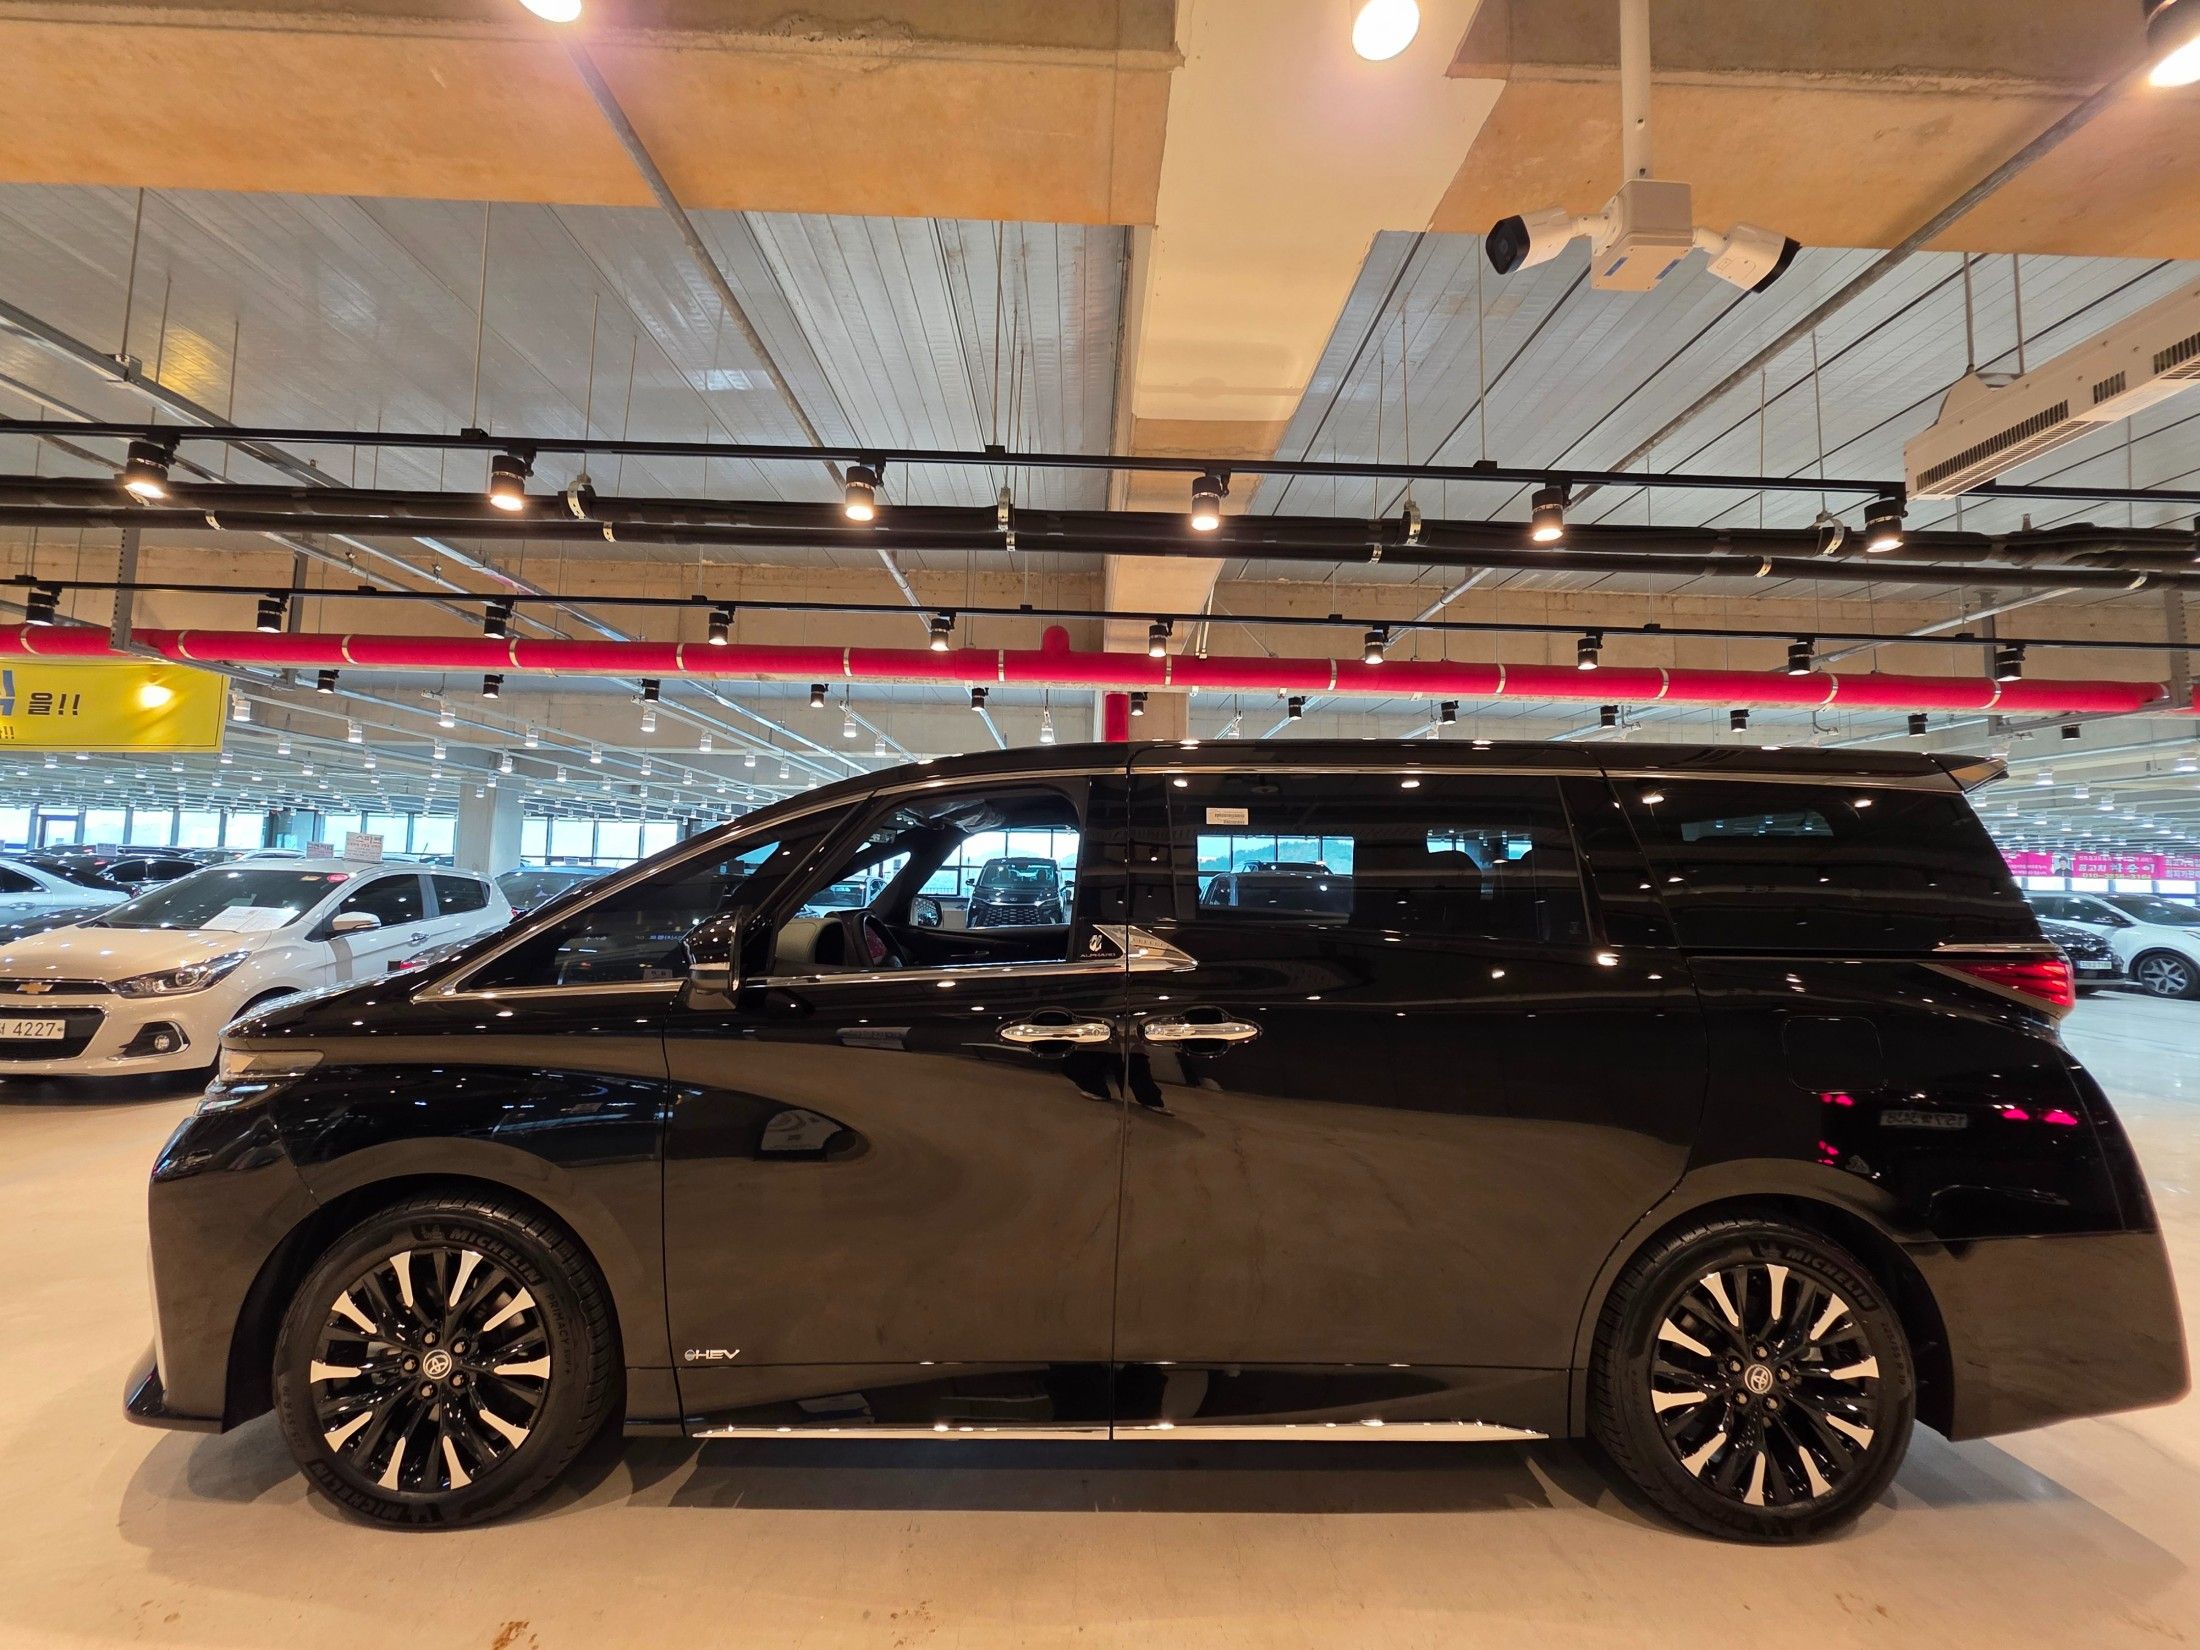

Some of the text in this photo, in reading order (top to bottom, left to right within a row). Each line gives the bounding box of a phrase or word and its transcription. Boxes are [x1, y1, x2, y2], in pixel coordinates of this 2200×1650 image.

[27, 692, 81, 716] 을!!
[12, 1022, 57, 1037] 4227
[451, 1227, 543, 1284] MICHELIN
[1786, 1249, 1878, 1311] MICHELIN
[695, 1349, 741, 1360] HEV
